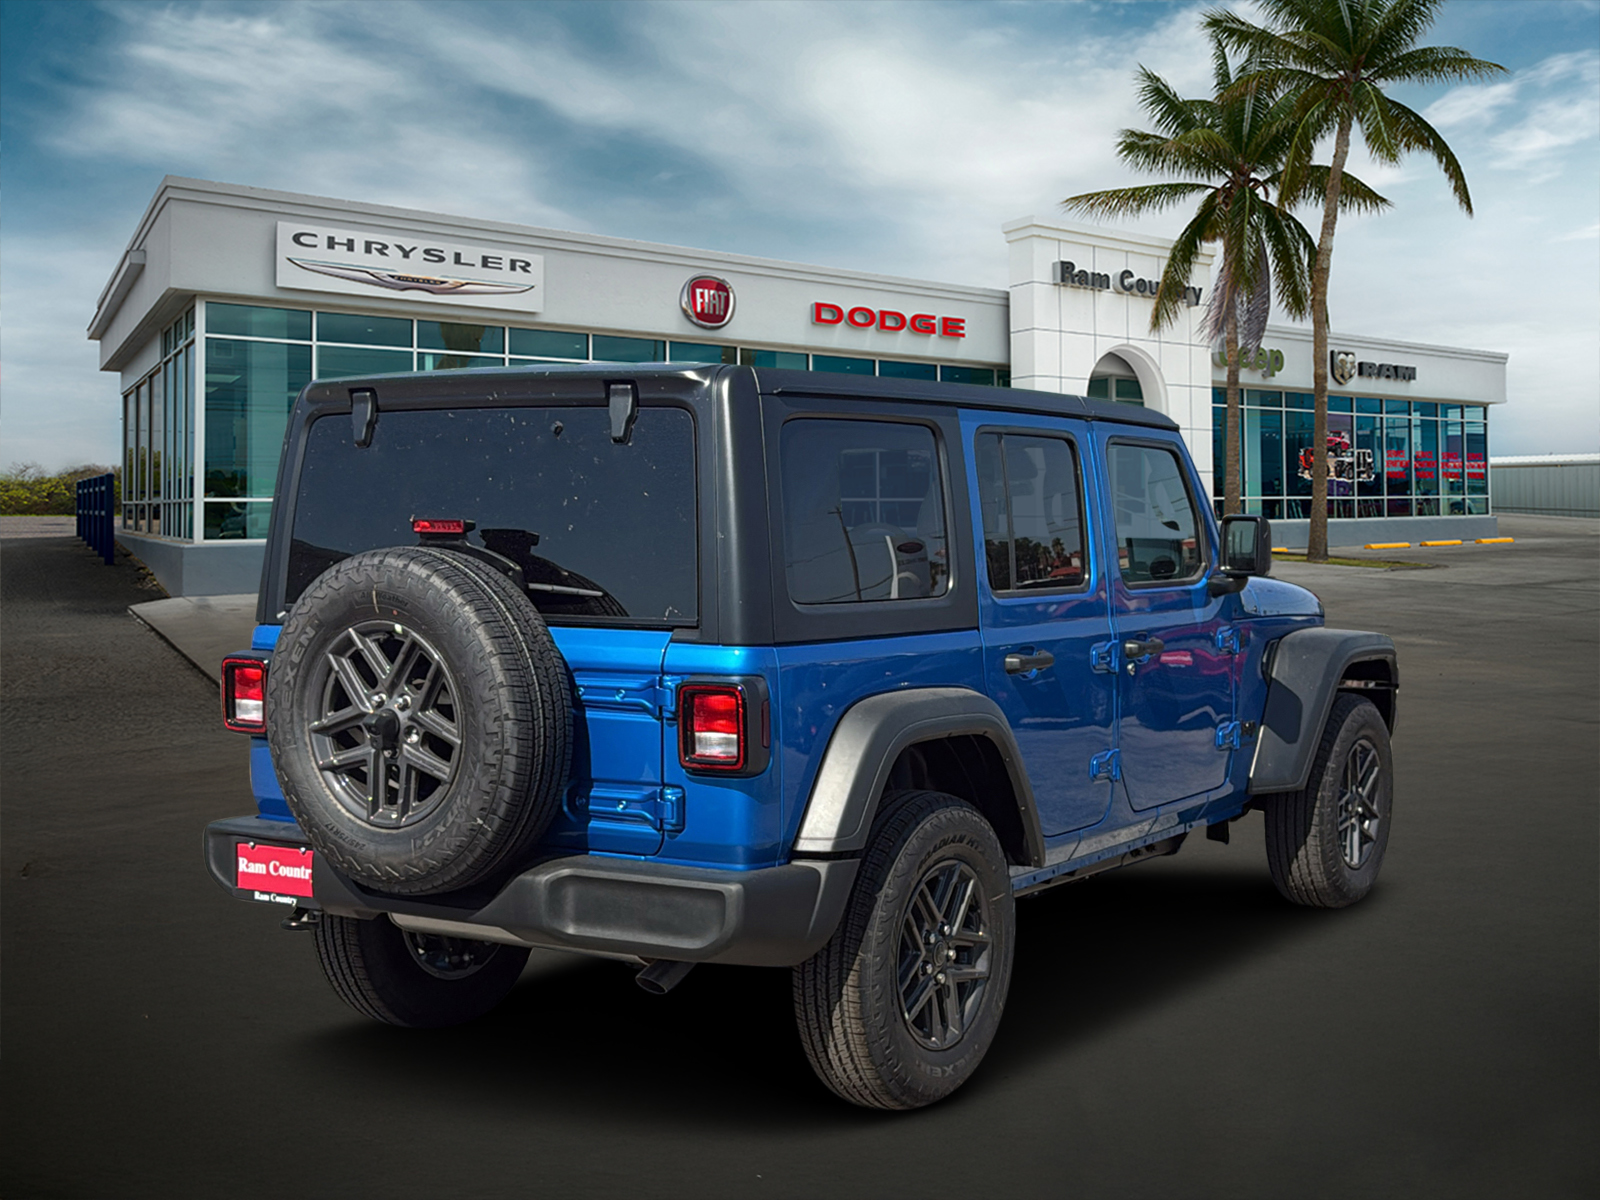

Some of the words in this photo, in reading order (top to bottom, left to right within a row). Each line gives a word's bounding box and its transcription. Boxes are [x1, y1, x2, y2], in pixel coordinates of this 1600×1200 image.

[291, 232, 533, 274] CHRYSLER
[1053, 260, 1111, 291] Ram
[1113, 269, 1203, 307] Coury
[694, 287, 728, 316] FIAT
[811, 301, 966, 338] DODGE
[1358, 361, 1417, 382] RAM
[238, 857, 267, 875] Ram
[269, 860, 313, 880] Countr
[254, 890, 270, 901] Ram
[270, 892, 297, 907] Country
